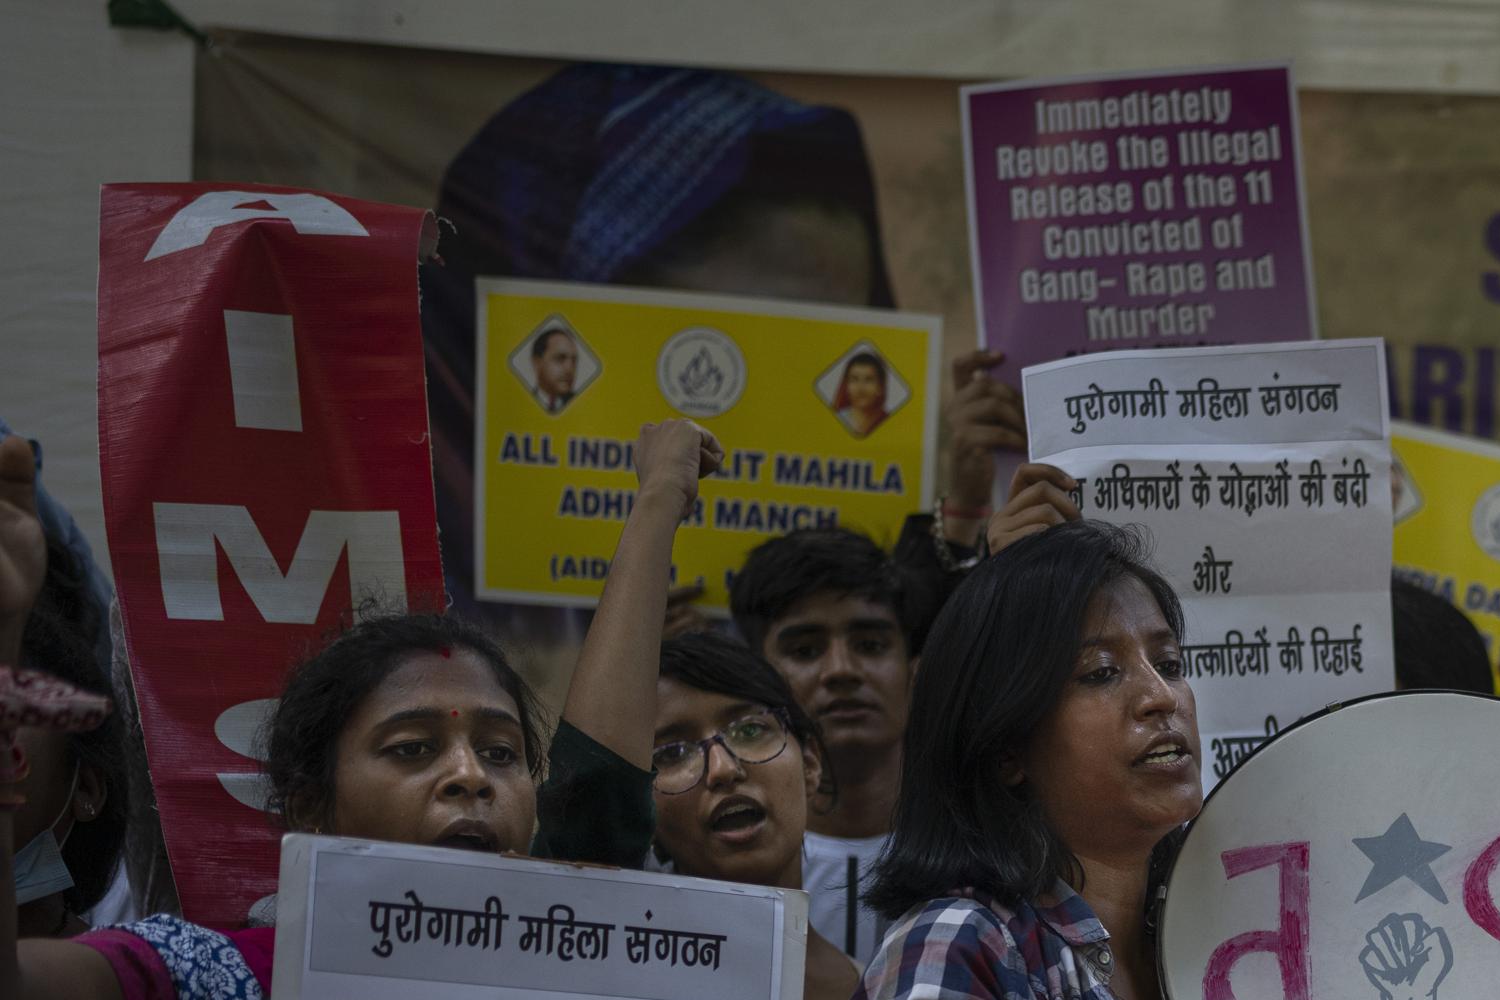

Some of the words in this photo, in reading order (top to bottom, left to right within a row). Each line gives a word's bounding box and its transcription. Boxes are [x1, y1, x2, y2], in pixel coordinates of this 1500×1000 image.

[1035, 87, 1232, 135] Immediately
[996, 140, 1108, 180] Revoke
[1117, 135, 1169, 171] the
[1178, 125, 1282, 166] Illegal
[1010, 181, 1133, 221] Release
[1143, 175, 1174, 211] of
[1184, 173, 1237, 208] the
[1244, 170, 1273, 204] 11
[1044, 217, 1202, 260] Convicted
[1212, 213, 1243, 248] of
[1126, 259, 1206, 297] Rape
[1216, 254, 1275, 291] and
[1086, 304, 1215, 341] Murder
[1064, 378, 1169, 434] पुरोगामी
[1176, 378, 1251, 421] महिला
[1258, 372, 1341, 415] संगठन
[500, 434, 557, 465] ALL
[568, 440, 634, 469] INDI
[776, 455, 903, 493] MAHILA
[1094, 459, 1183, 512] अधिकारों
[1190, 464, 1211, 511] के
[1299, 460, 1327, 508] की
[1332, 457, 1370, 508] बंदी
[715, 498, 839, 532] MANCH
[1193, 545, 1233, 593] और
[1277, 627, 1305, 674] की
[1311, 624, 1363, 676] रिहाई
[369, 890, 509, 958] पुरोगामी
[519, 905, 616, 961] महिला
[625, 910, 727, 971] संगठन
